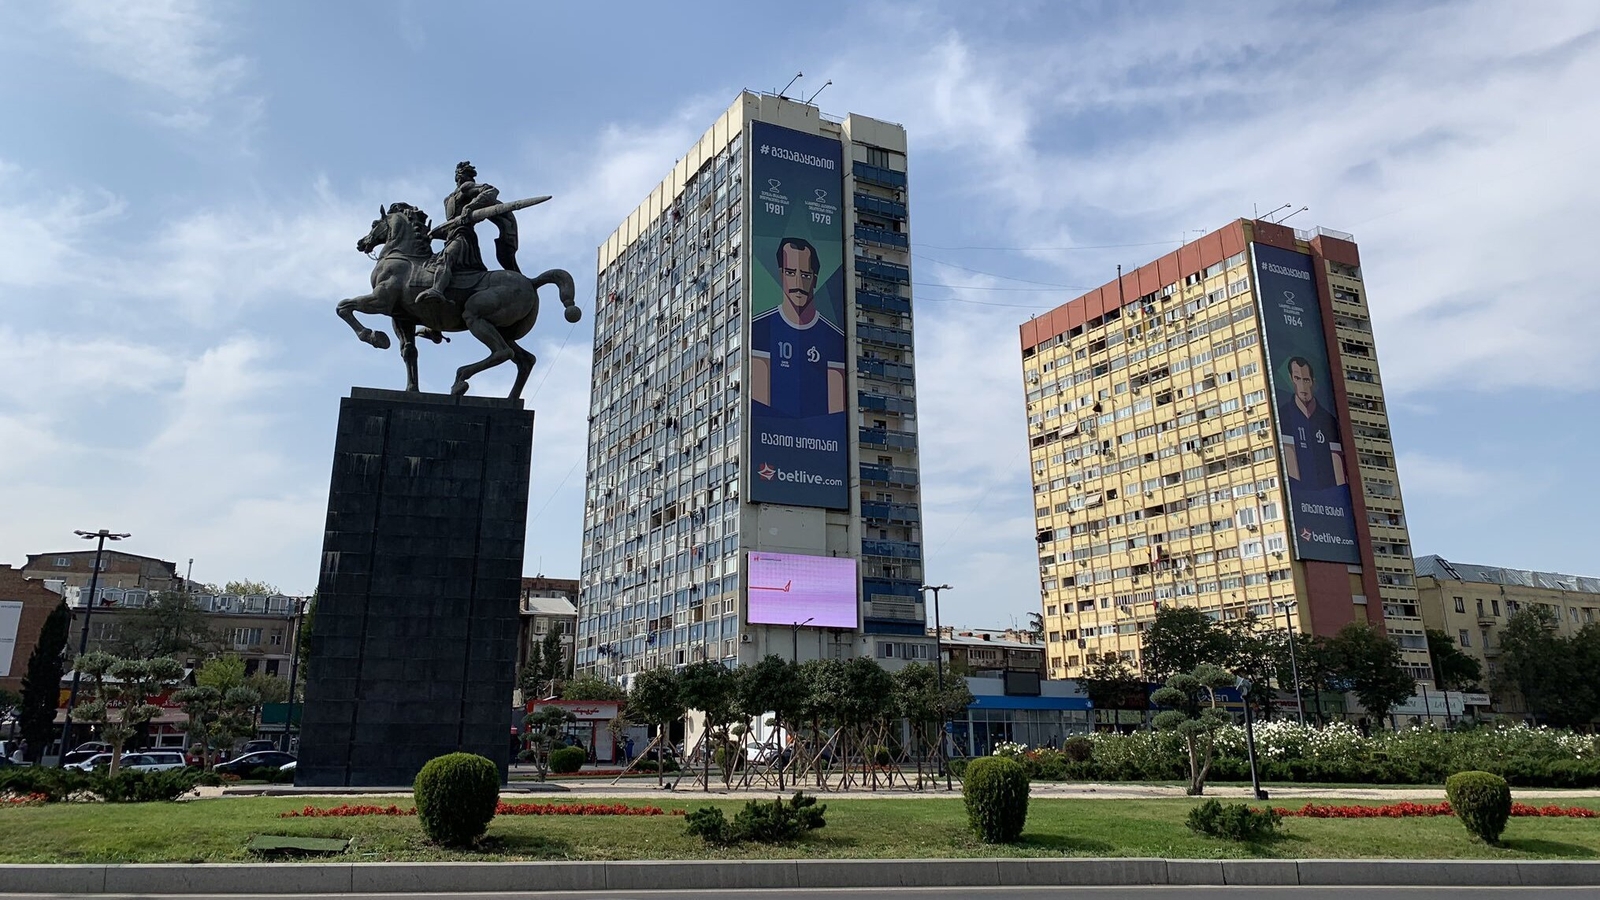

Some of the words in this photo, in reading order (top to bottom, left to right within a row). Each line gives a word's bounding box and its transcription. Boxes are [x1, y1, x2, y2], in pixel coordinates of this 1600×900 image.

[765, 202, 784, 216] 1981
[811, 212, 831, 225] 1978
[1283, 314, 1303, 327] 1964
[778, 341, 792, 359] 10
[1298, 427, 1306, 441] 11
[761, 432, 794, 448] დავით
[795, 437, 838, 452] ყიფიანი
[777, 468, 843, 487] betlive.com
[1312, 531, 1354, 546] betlive.com
